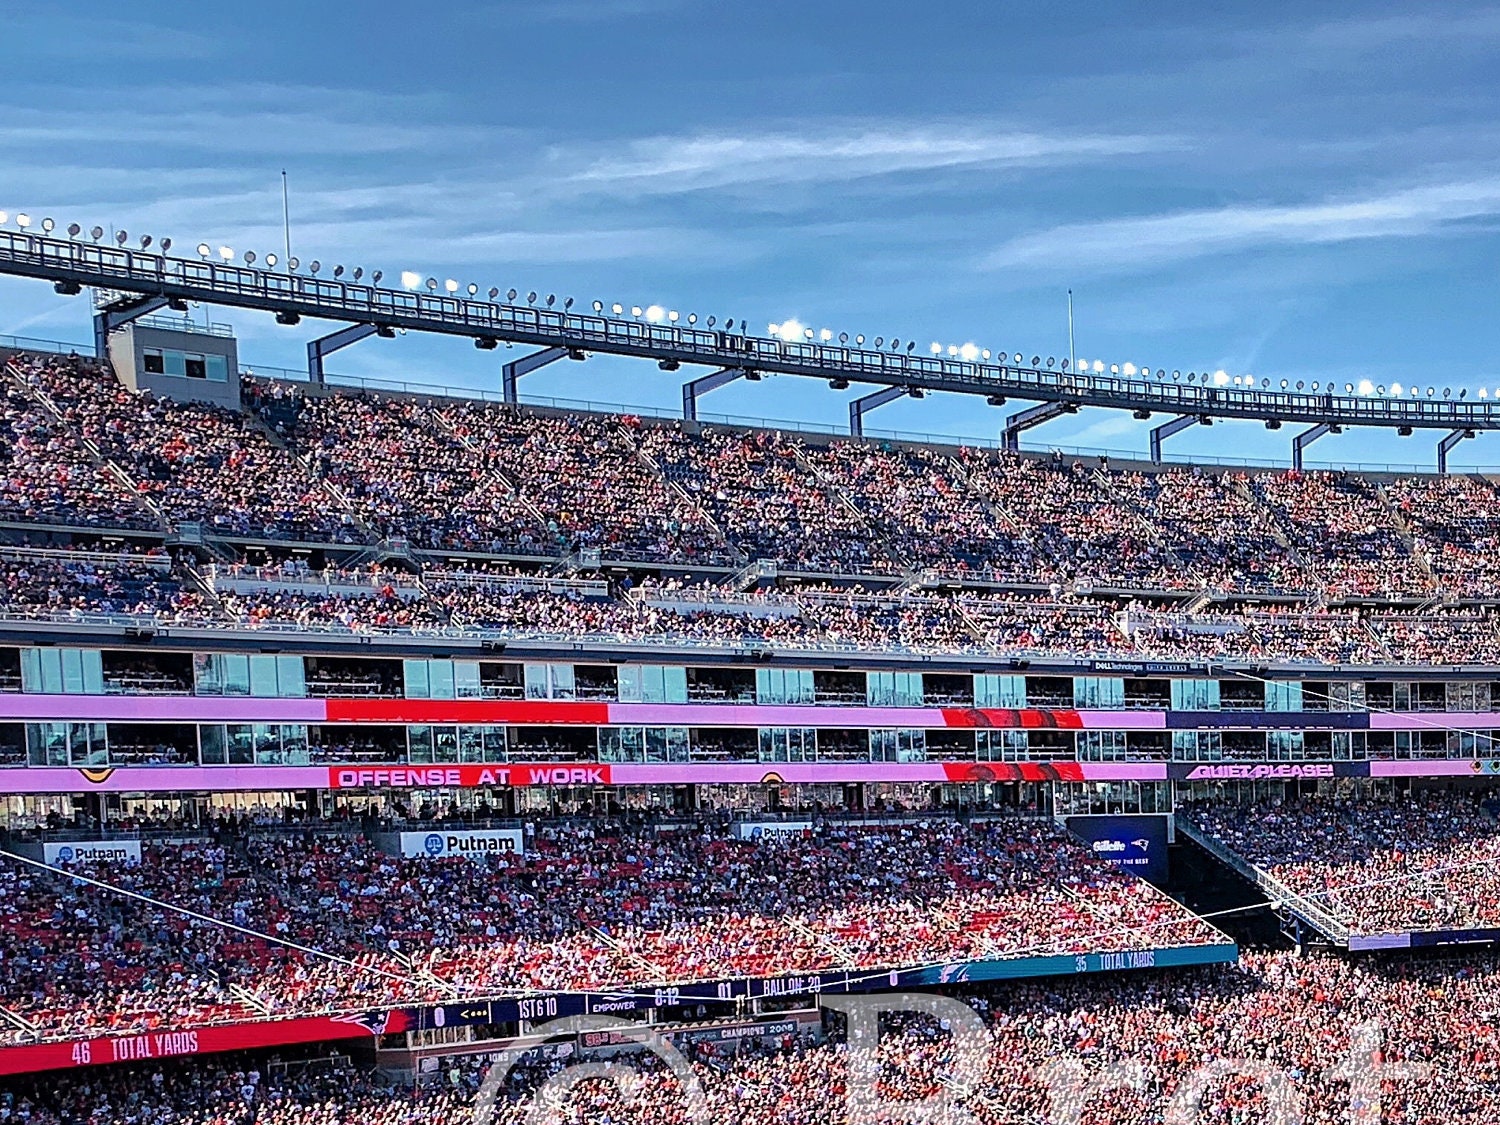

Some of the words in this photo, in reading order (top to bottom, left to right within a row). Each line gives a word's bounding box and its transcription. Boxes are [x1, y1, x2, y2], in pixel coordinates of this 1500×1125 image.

[338, 769, 461, 787] OFFENSE
[477, 768, 510, 785] AT
[530, 767, 604, 784] WORK
[447, 835, 516, 853] Putnam
[1076, 955, 1087, 973] 35
[1100, 953, 1126, 970] TOTAL
[1126, 950, 1155, 968] YARDS
[807, 976, 821, 993] 20
[592, 1000, 636, 1012] EMPOWER
[654, 988, 680, 1007] 8:12
[517, 1000, 536, 1018] 1ST
[545, 998, 558, 1016] 10
[720, 1026, 765, 1039] CHAMPIONS
[71, 1042, 91, 1065] 46
[112, 1035, 155, 1062] TOTAL
[155, 1031, 199, 1055] YARDS
